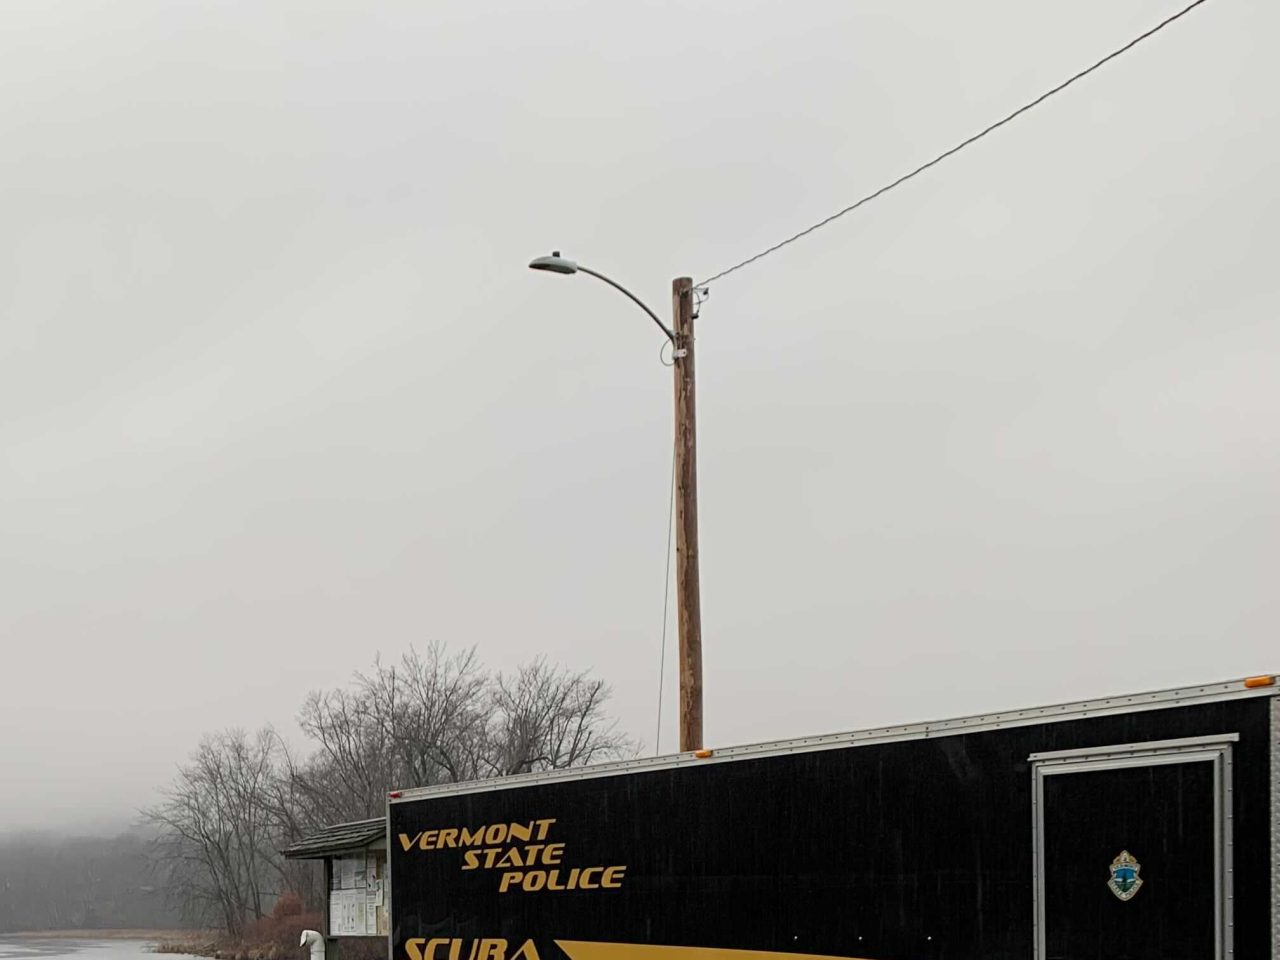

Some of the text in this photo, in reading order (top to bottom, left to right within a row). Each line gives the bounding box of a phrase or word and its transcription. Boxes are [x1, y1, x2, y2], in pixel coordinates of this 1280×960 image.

[398, 818, 557, 852] VERMONT
[461, 842, 566, 870] STATE
[498, 865, 627, 893] POLICE
